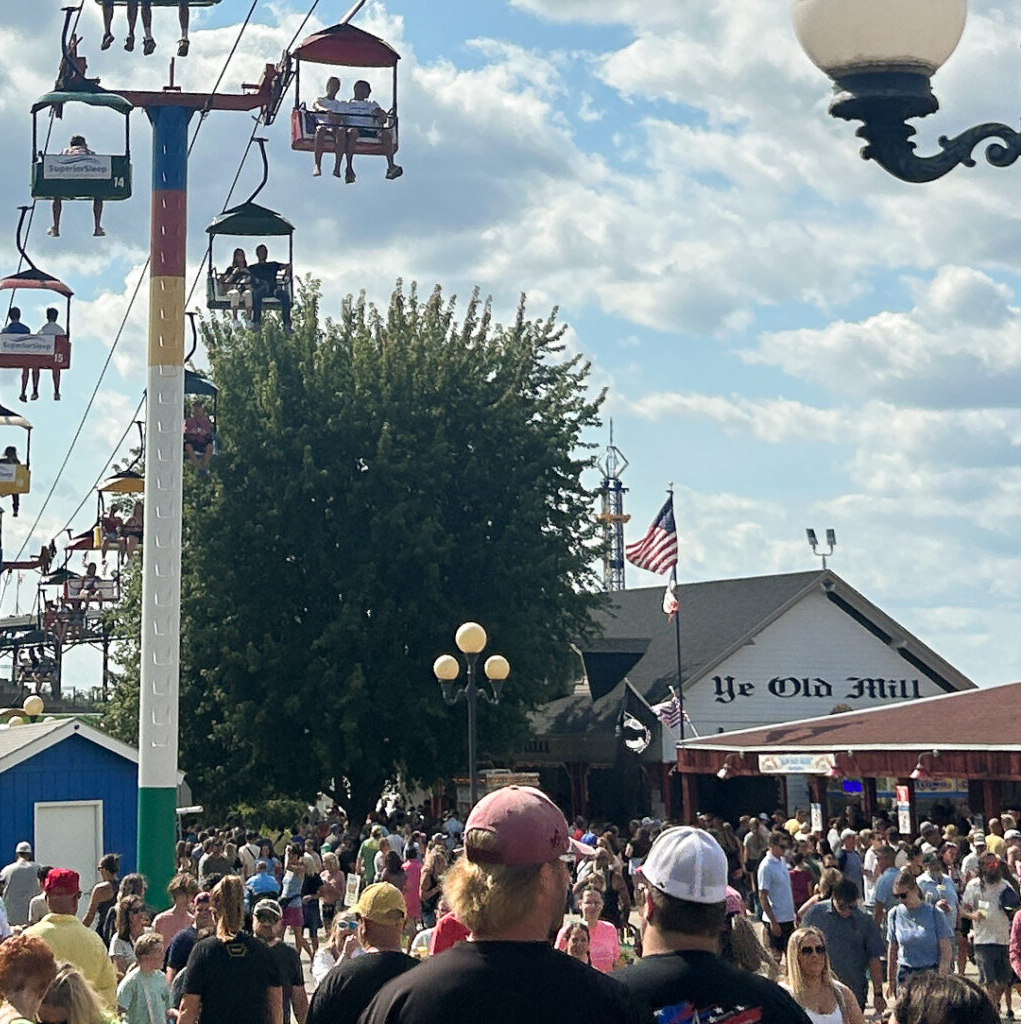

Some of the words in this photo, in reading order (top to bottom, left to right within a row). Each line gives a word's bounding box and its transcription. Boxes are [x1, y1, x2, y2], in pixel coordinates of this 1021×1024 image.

[48, 164, 107, 174] SuperiorSleep
[113, 177, 125, 188] 14
[711, 675, 755, 704] Ye
[768, 676, 833, 698] Old
[845, 676, 924, 700] Mill
